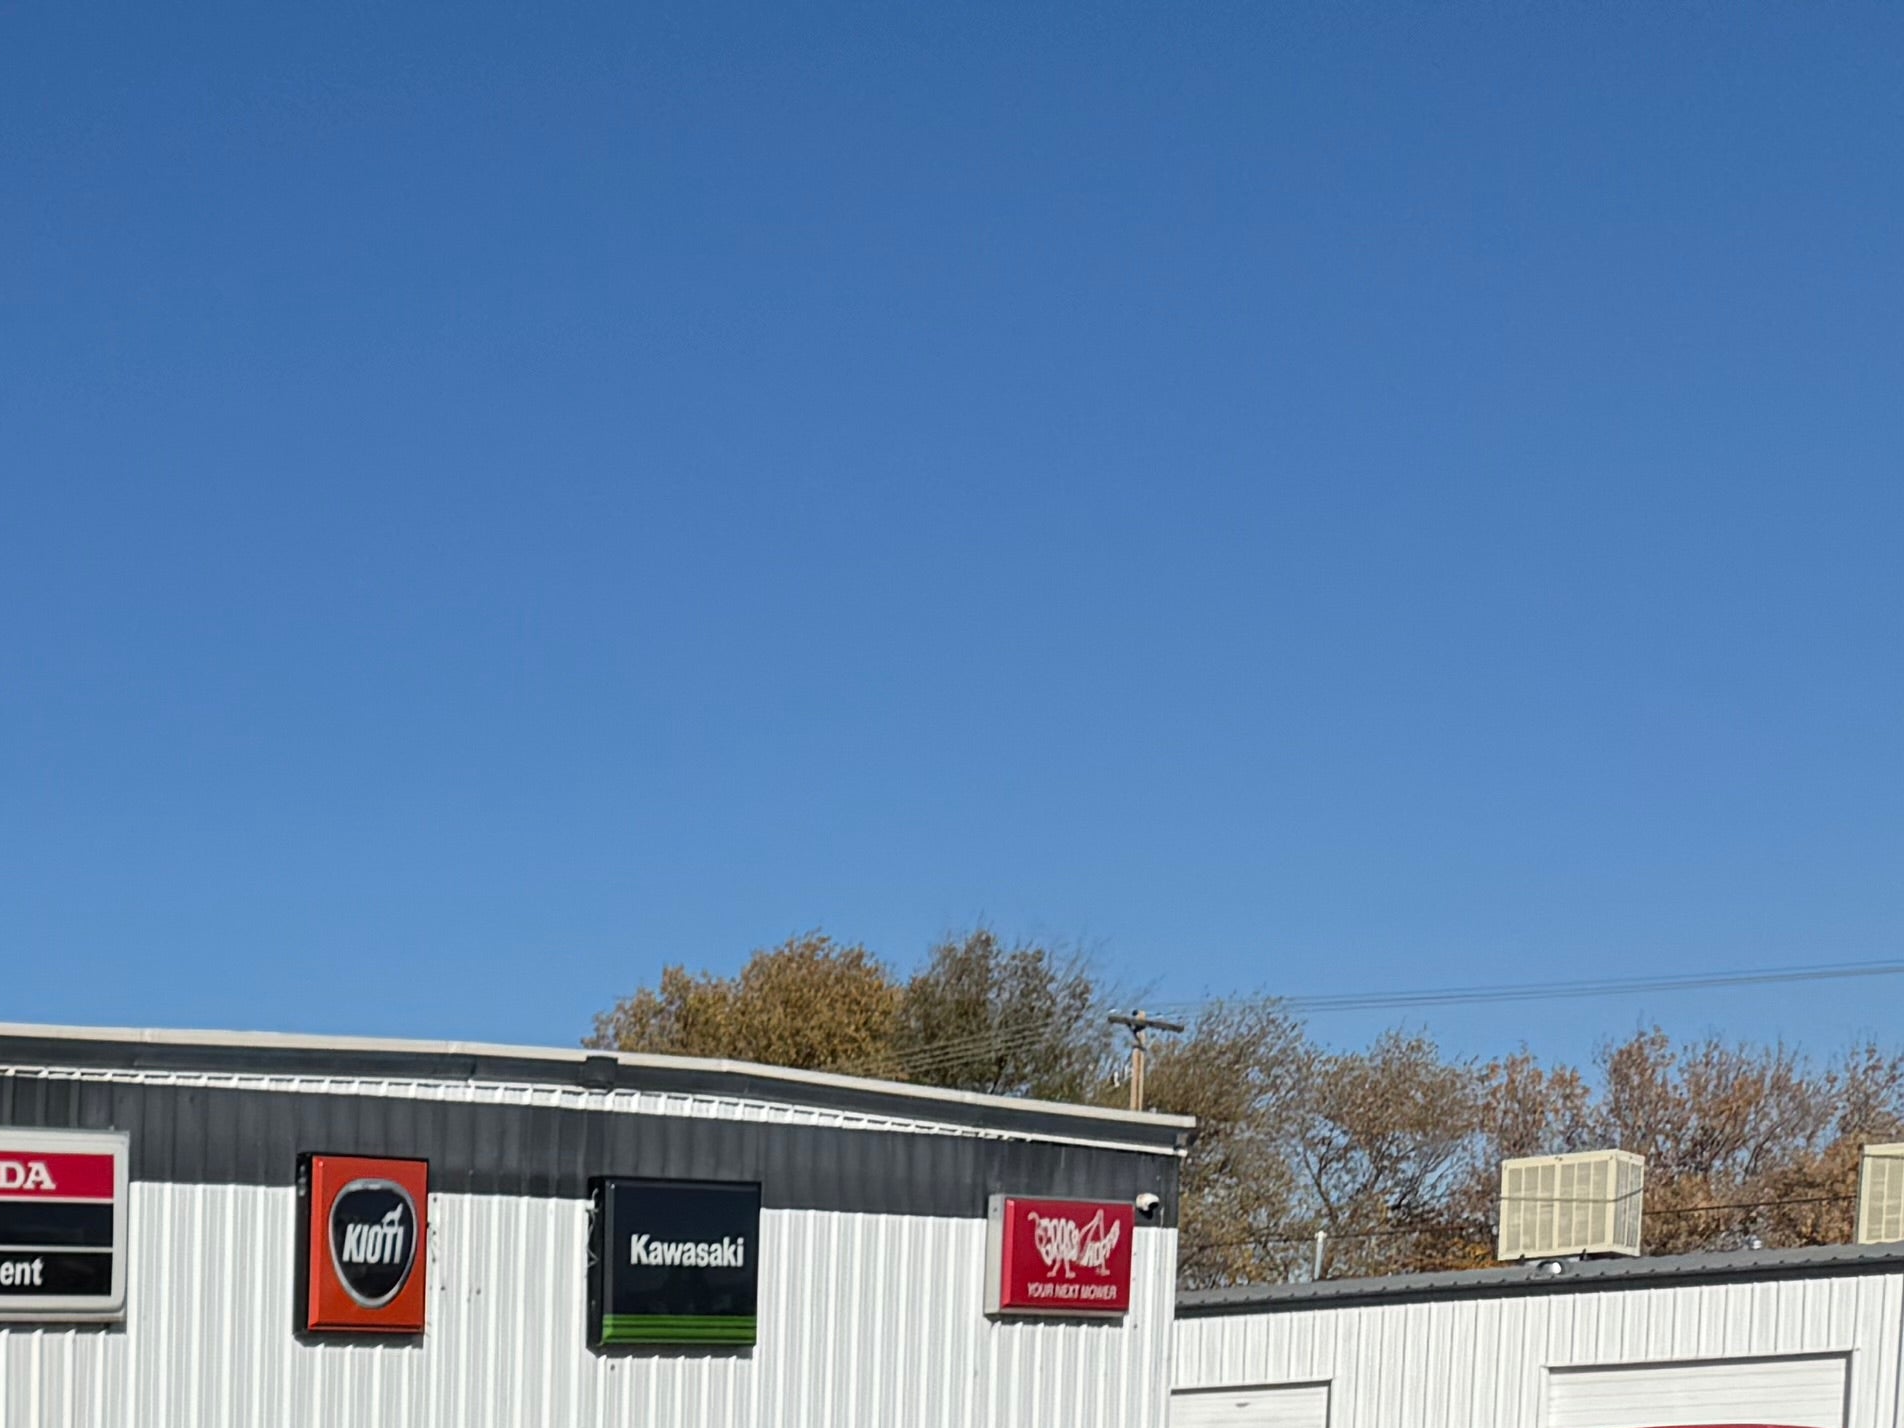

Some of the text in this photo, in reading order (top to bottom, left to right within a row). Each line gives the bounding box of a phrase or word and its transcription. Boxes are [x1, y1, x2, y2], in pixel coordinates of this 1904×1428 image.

[342, 1219, 404, 1264] KIOTI
[630, 1233, 744, 1267] Kawasaki
[1055, 1283, 1079, 1298] NEXT
[1080, 1284, 1117, 1300] MOWER
